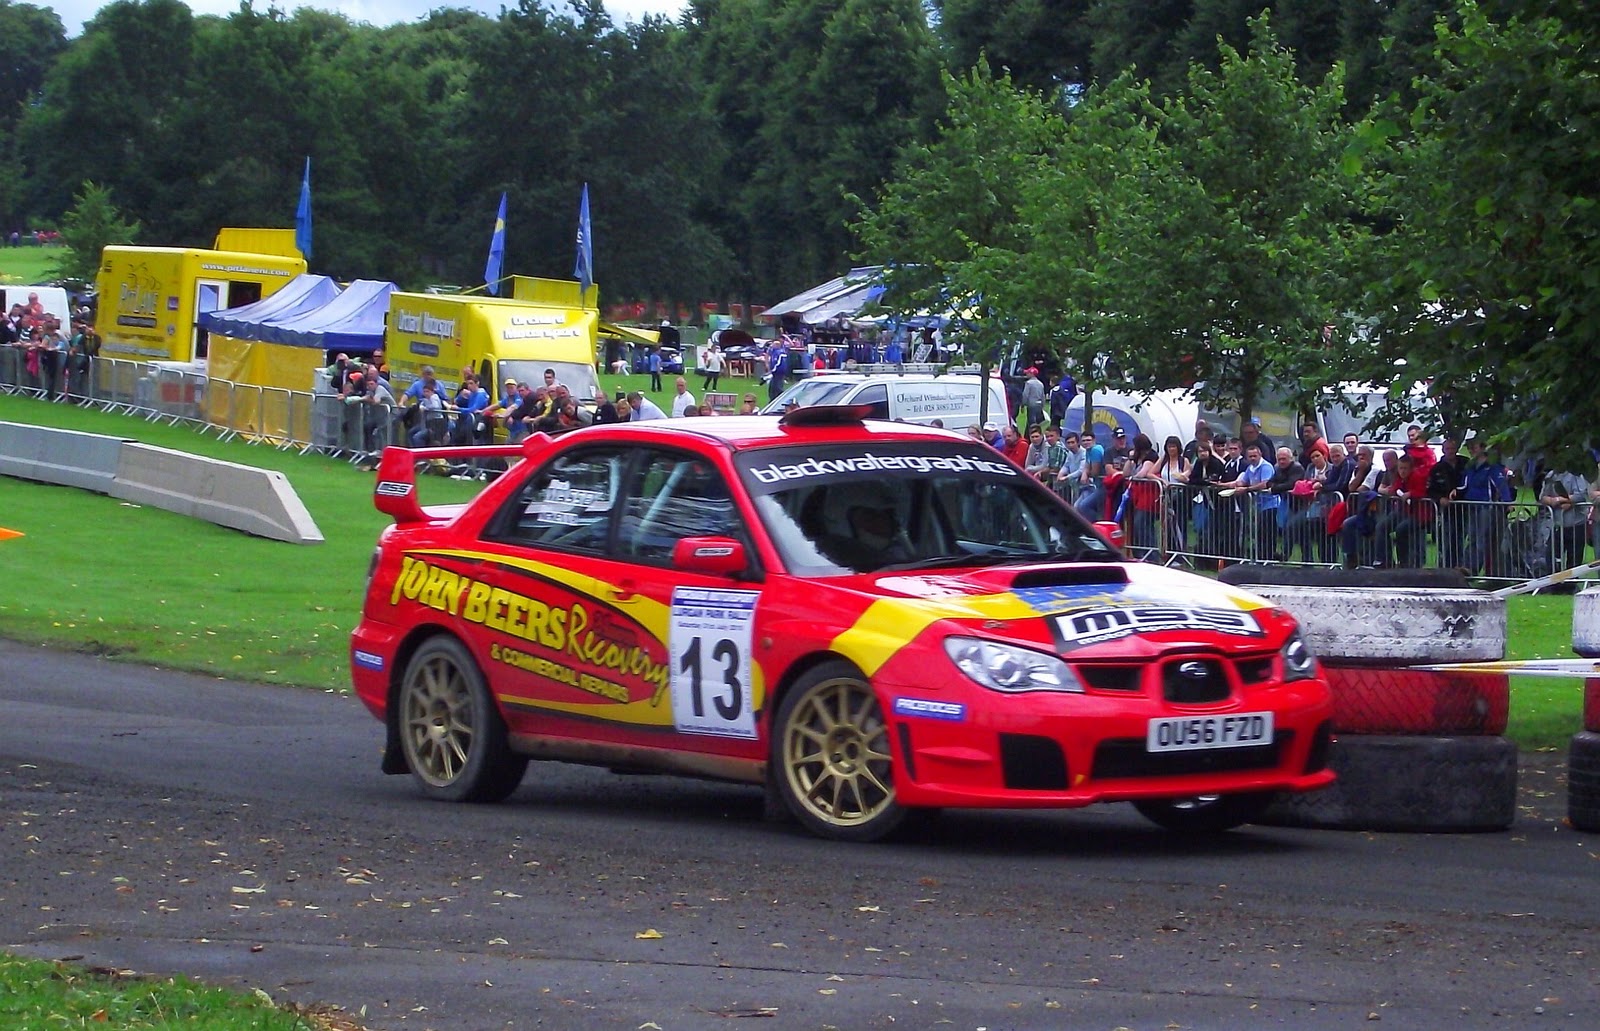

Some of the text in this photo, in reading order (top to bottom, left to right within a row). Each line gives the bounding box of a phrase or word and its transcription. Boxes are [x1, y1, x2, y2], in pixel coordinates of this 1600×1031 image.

[750, 453, 1017, 483] blackwatergraphics
[391, 556, 470, 616] JOHN
[463, 581, 567, 650] BEERS
[502, 648, 579, 687] COMMERCIAL
[579, 674, 629, 703] REPAIRS
[680, 636, 742, 721] 13
[1158, 716, 1265, 746] OU56 FZD
